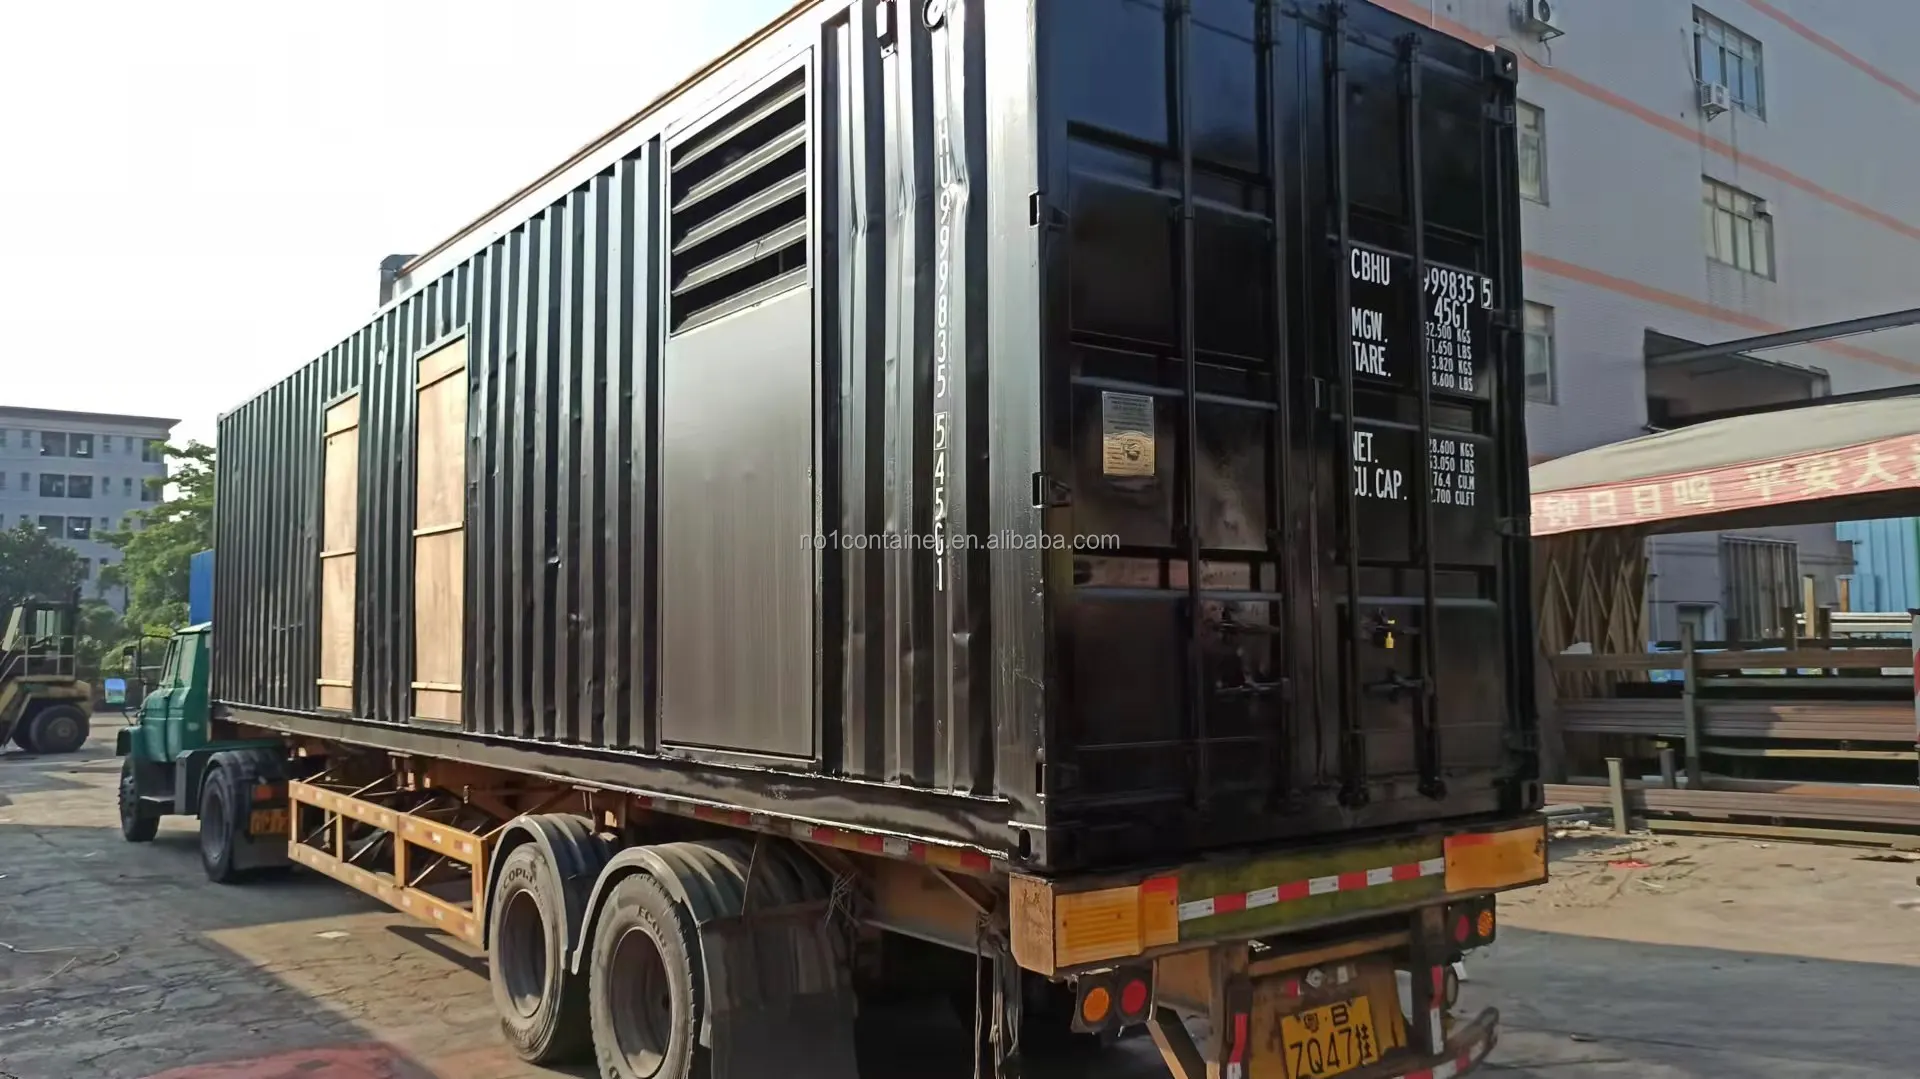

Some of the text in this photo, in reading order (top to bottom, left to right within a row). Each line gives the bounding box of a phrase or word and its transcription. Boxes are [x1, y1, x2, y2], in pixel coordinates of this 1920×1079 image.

[1351, 248, 1390, 286] CBHU
[1482, 279, 1491, 307] 5
[1351, 306, 1471, 344] MGW. 32.500 KGS
[1434, 296, 1468, 330] 45G1
[1352, 341, 1392, 377] TARE.
[1458, 359, 1473, 376] KGS
[1457, 343, 1472, 360] LBS
[1459, 375, 1473, 392] LBS
[1460, 442, 1475, 458] KGS
[1460, 458, 1475, 474] LBS
[1375, 467, 1408, 501] CAP.
